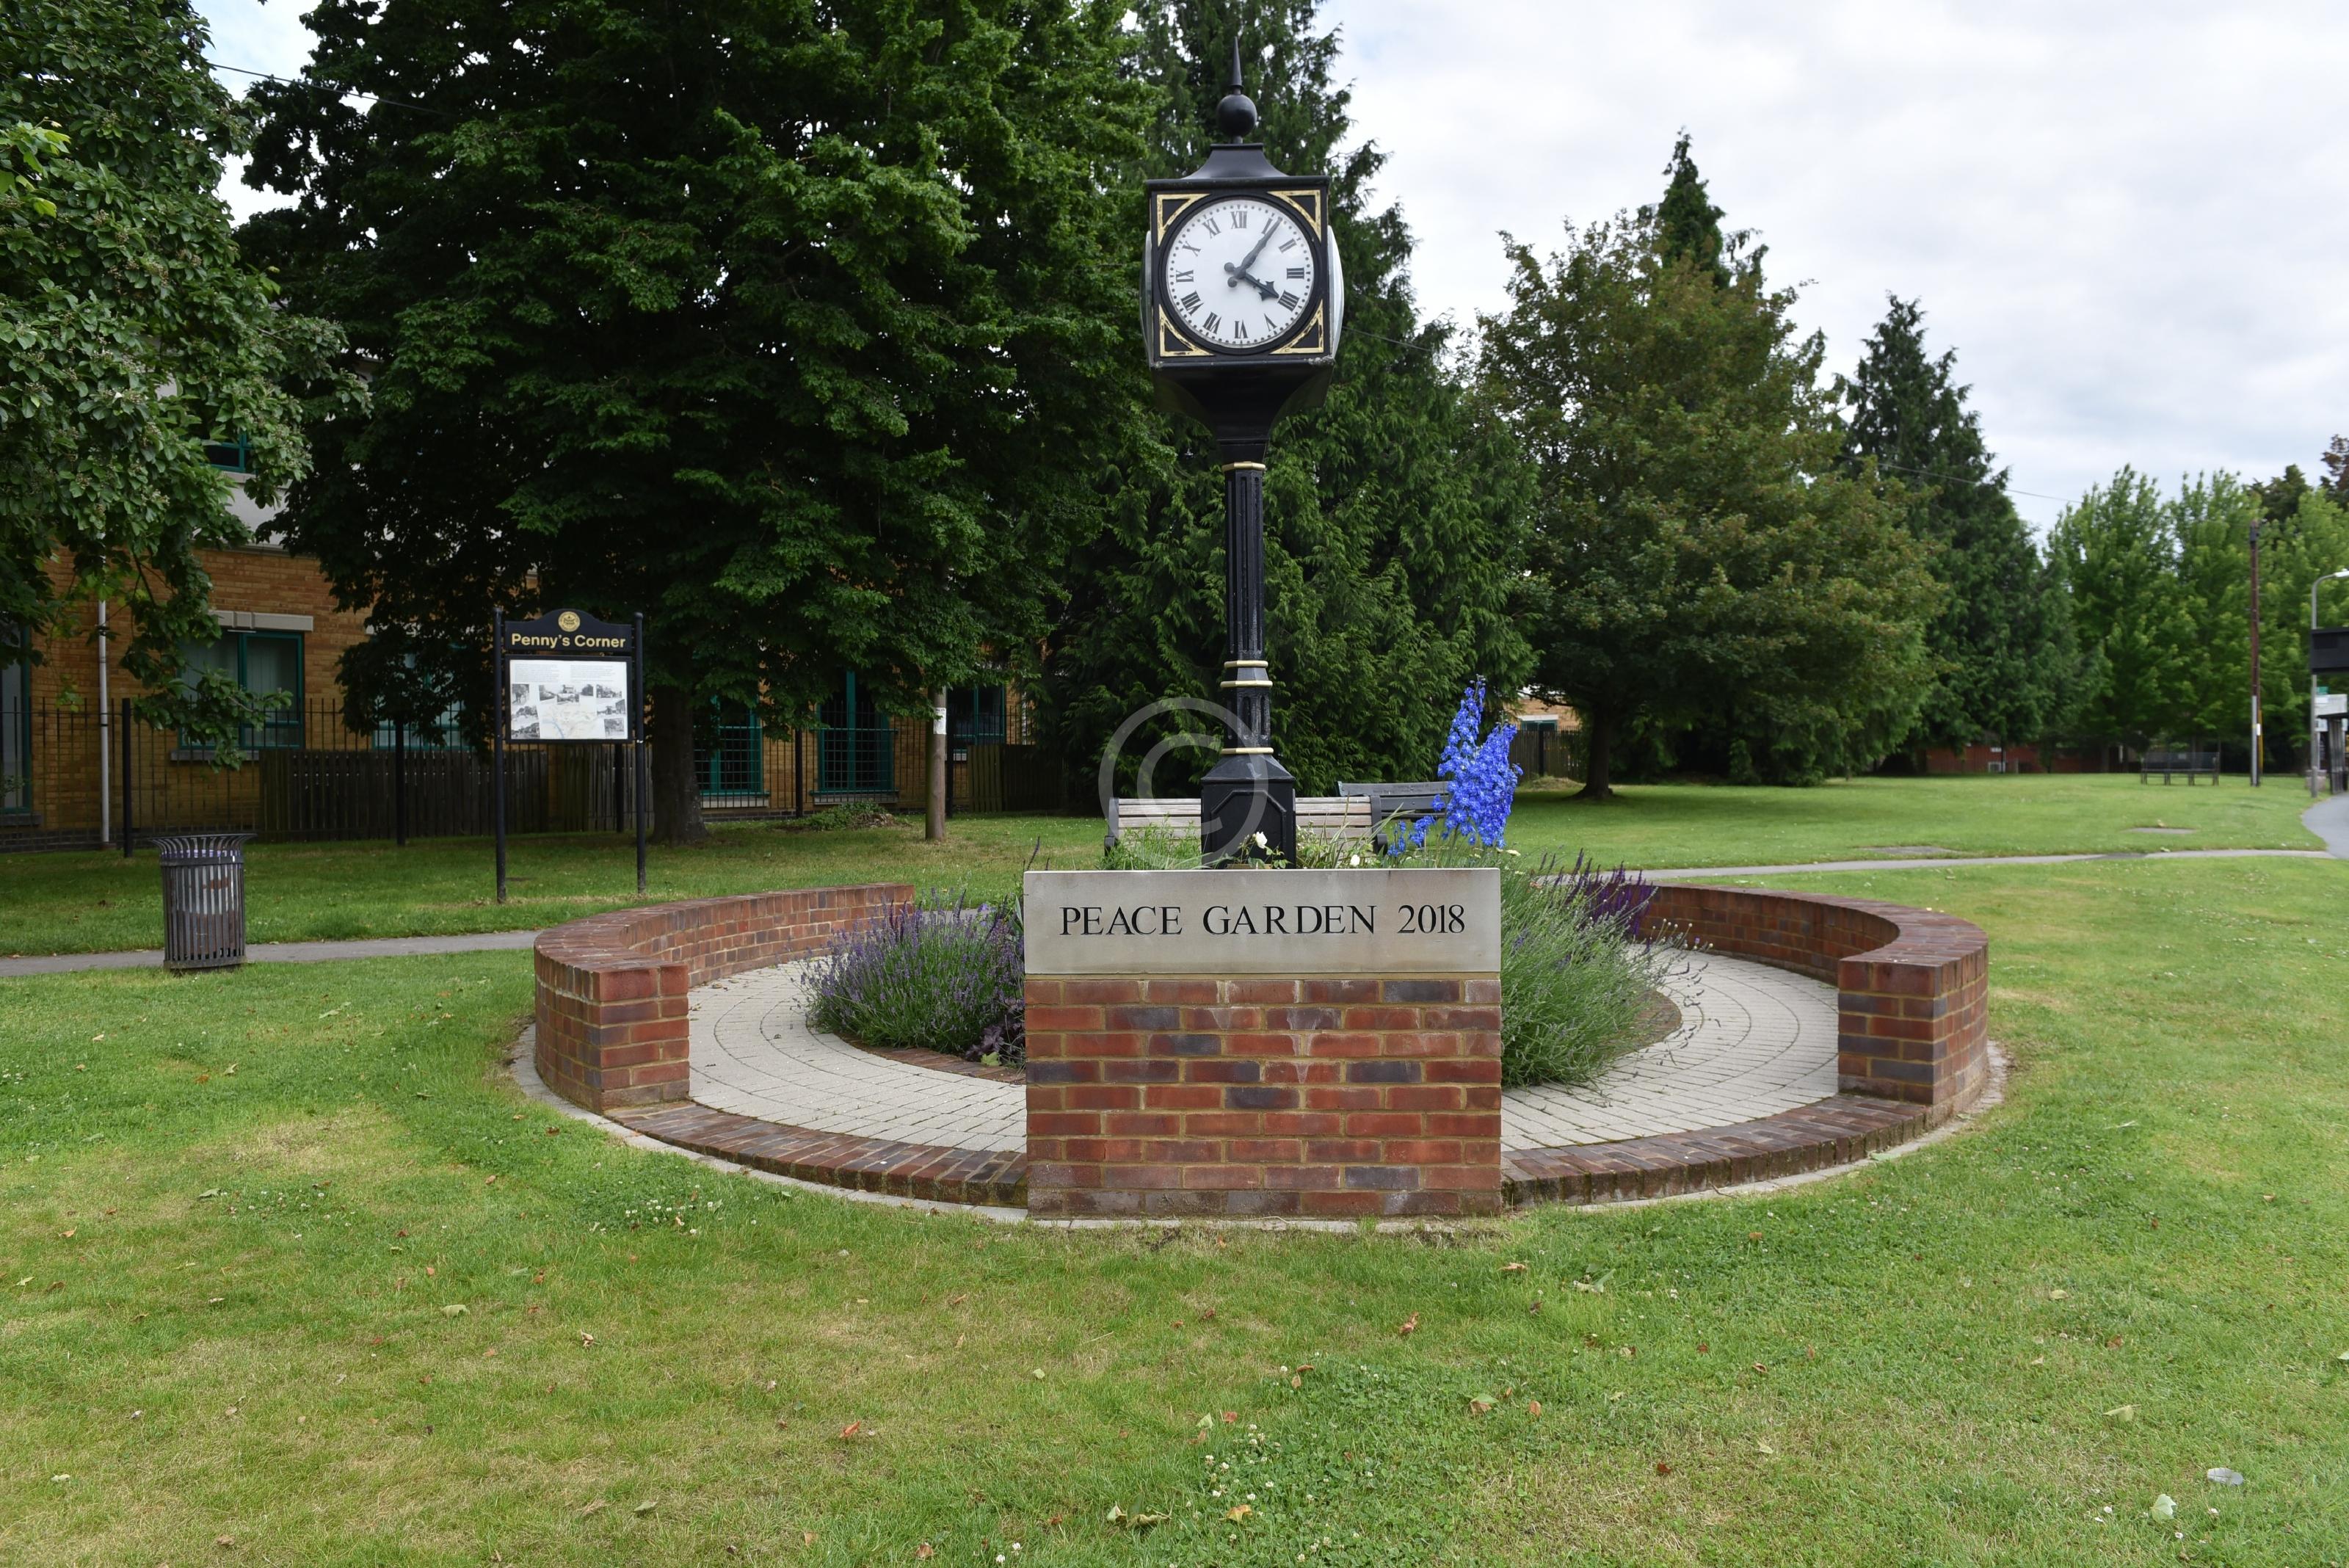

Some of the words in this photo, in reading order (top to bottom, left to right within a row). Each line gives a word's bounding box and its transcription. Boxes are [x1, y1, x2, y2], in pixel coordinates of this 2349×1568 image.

[1202, 217, 1221, 239] XI
[1230, 210, 1249, 230] XII
[1182, 240, 1202, 258] X
[1278, 238, 1297, 253] II
[1175, 269, 1194, 283] IX
[1286, 267, 1305, 280] III
[1180, 289, 1205, 316] VIII
[1277, 289, 1300, 312] IIII
[1202, 311, 1222, 335] VII
[1234, 319, 1249, 339] VI
[1263, 313, 1278, 332] V
[512, 633, 570, 649] Penny's
[574, 634, 626, 647] Corner
[1059, 905, 1183, 936] PEACE
[1202, 904, 1378, 935] GARDEN
[1396, 904, 1465, 934] 2018
